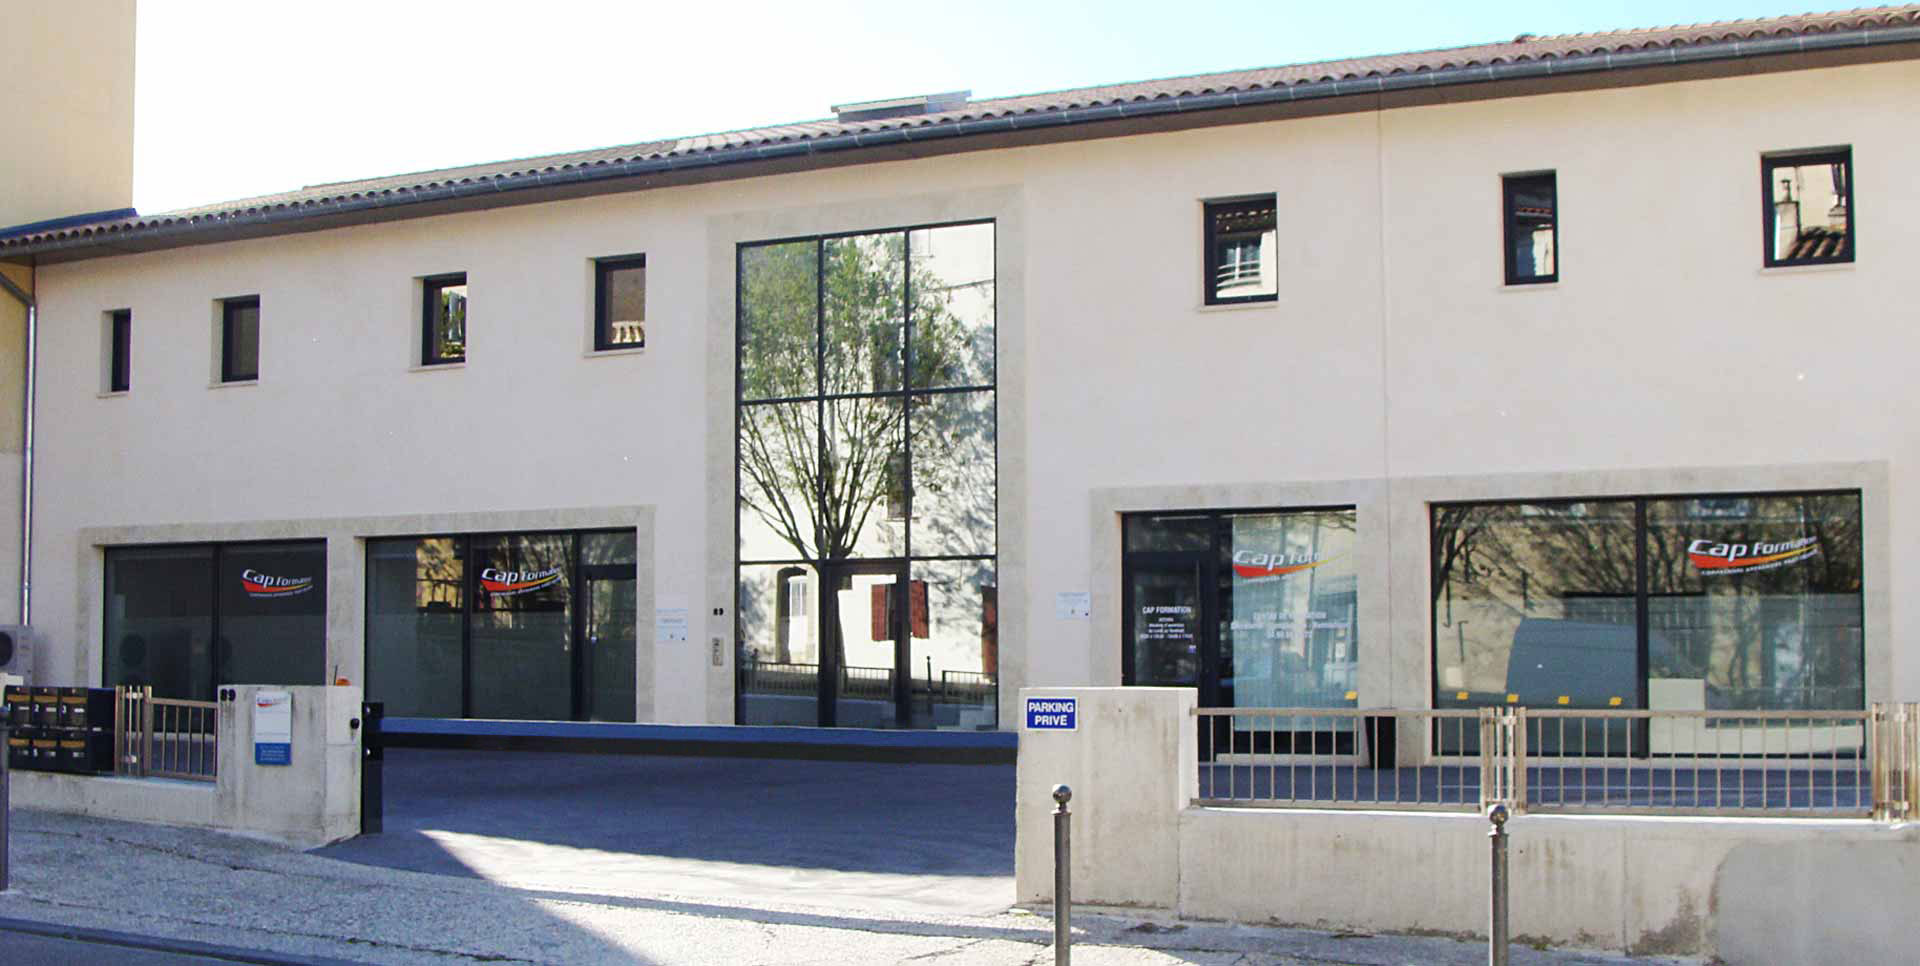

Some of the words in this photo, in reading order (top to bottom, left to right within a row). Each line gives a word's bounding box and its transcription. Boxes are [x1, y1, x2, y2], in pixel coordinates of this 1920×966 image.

[1688, 539, 1748, 562] Cap
[1233, 550, 1284, 571] Cap
[243, 569, 274, 588] Cap
[481, 568, 518, 586] Cap
[1142, 606, 1155, 614] CAP
[1156, 606, 1192, 614] FORMATION
[1028, 702, 1074, 713] PARKING
